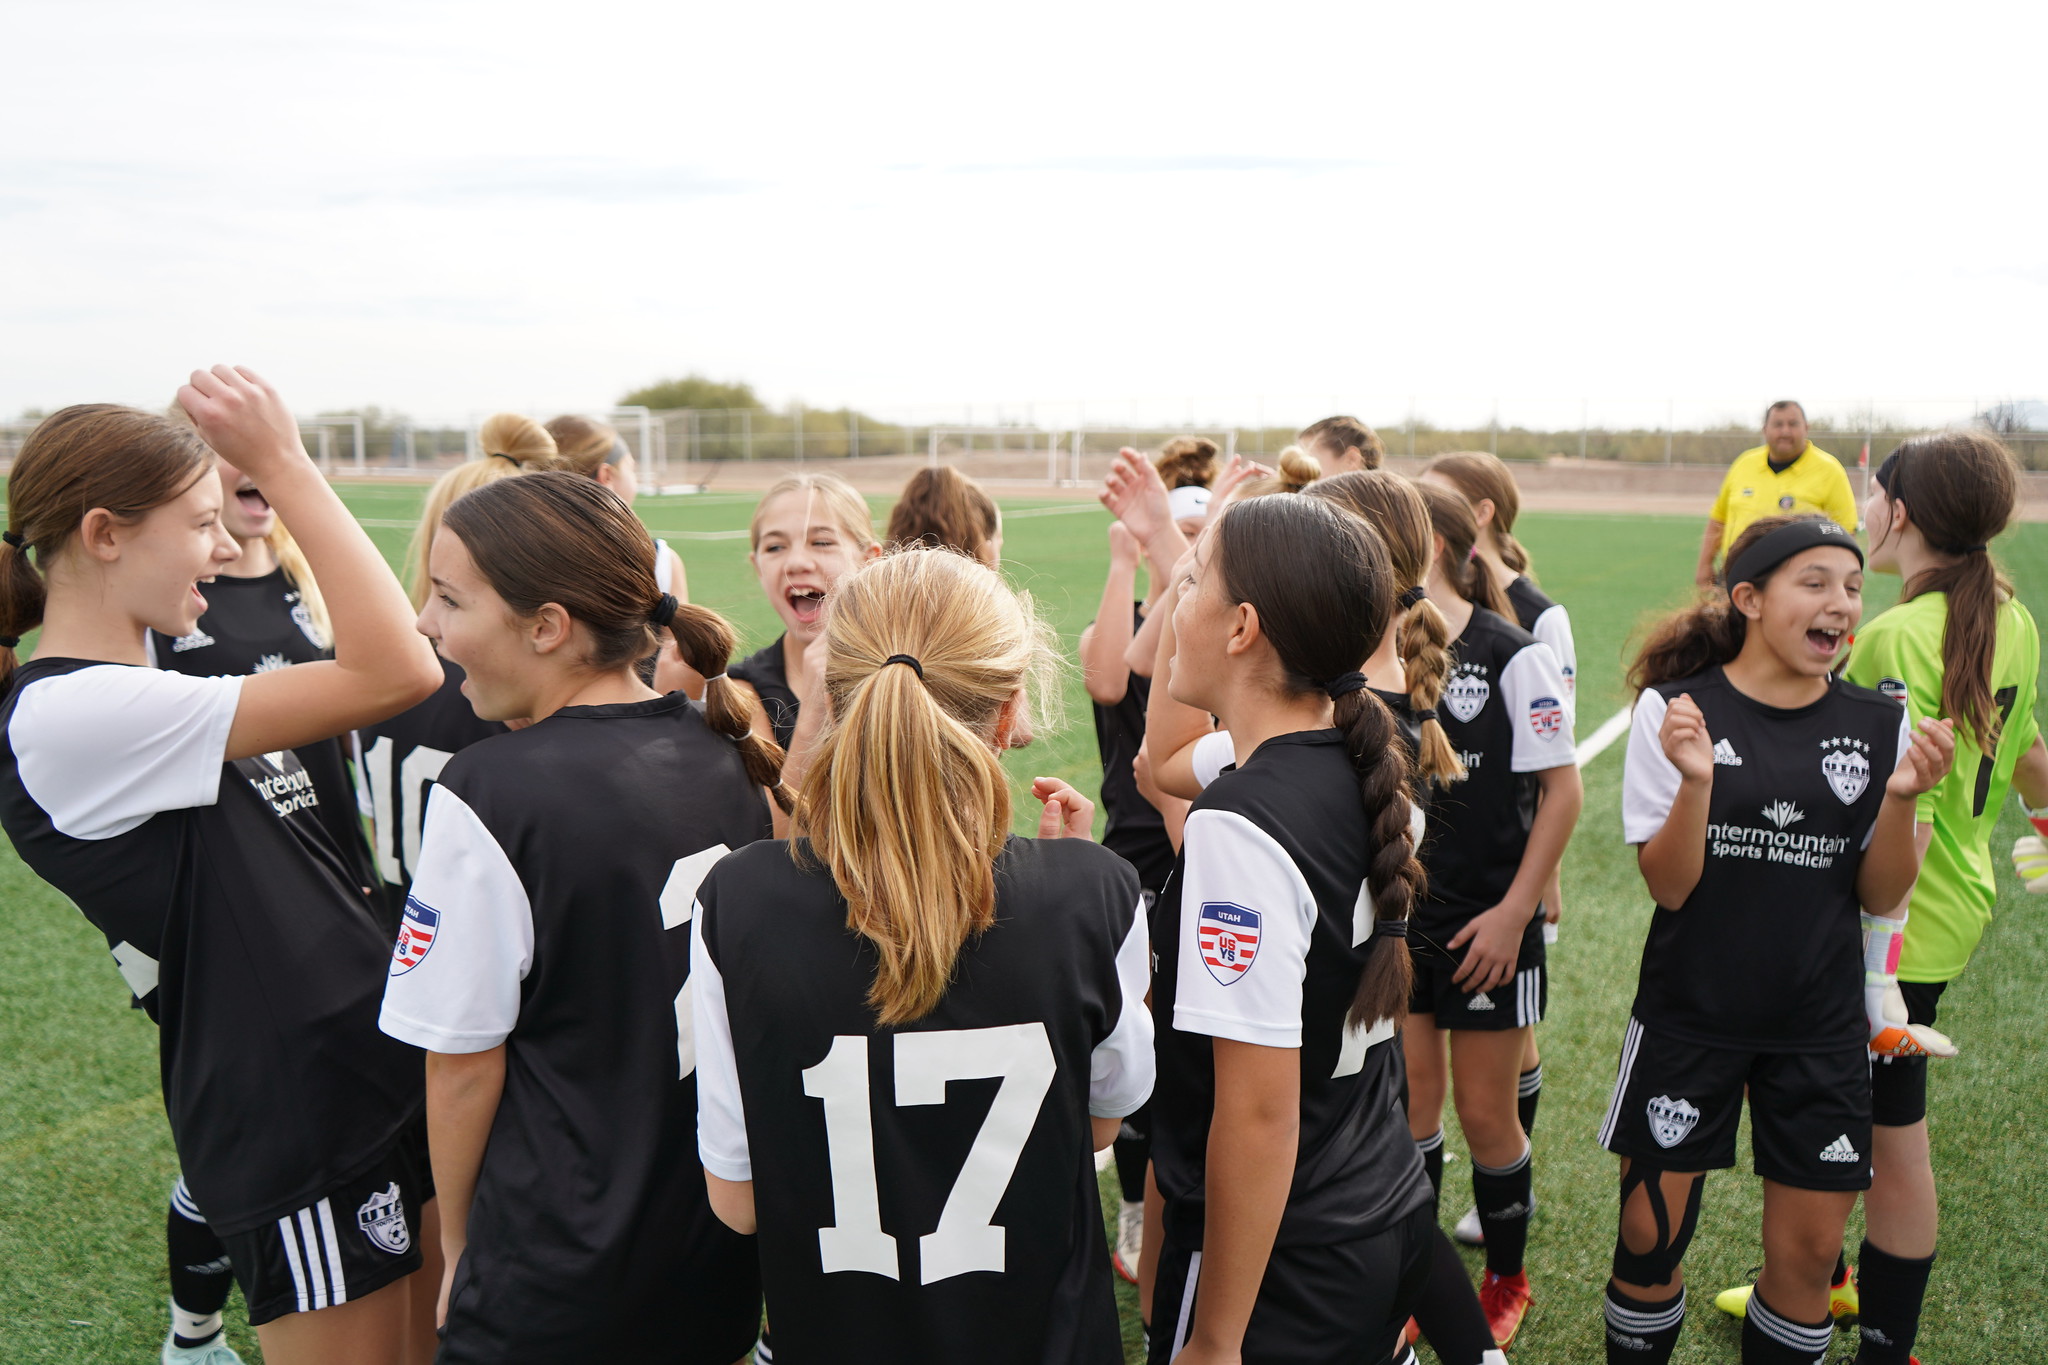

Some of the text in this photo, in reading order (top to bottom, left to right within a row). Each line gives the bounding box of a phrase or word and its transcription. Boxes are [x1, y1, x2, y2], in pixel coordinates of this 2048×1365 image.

[1707, 822, 1845, 854] ntermountain
[1712, 840, 1833, 869] Sports Medicine
[1218, 911, 1241, 923] UTAH
[1219, 936, 1236, 951] US
[1220, 947, 1236, 962] YS
[1649, 1101, 1699, 1124] UTAH
[802, 1022, 1057, 1286] 17
[1819, 1150, 1860, 1163] adidas
